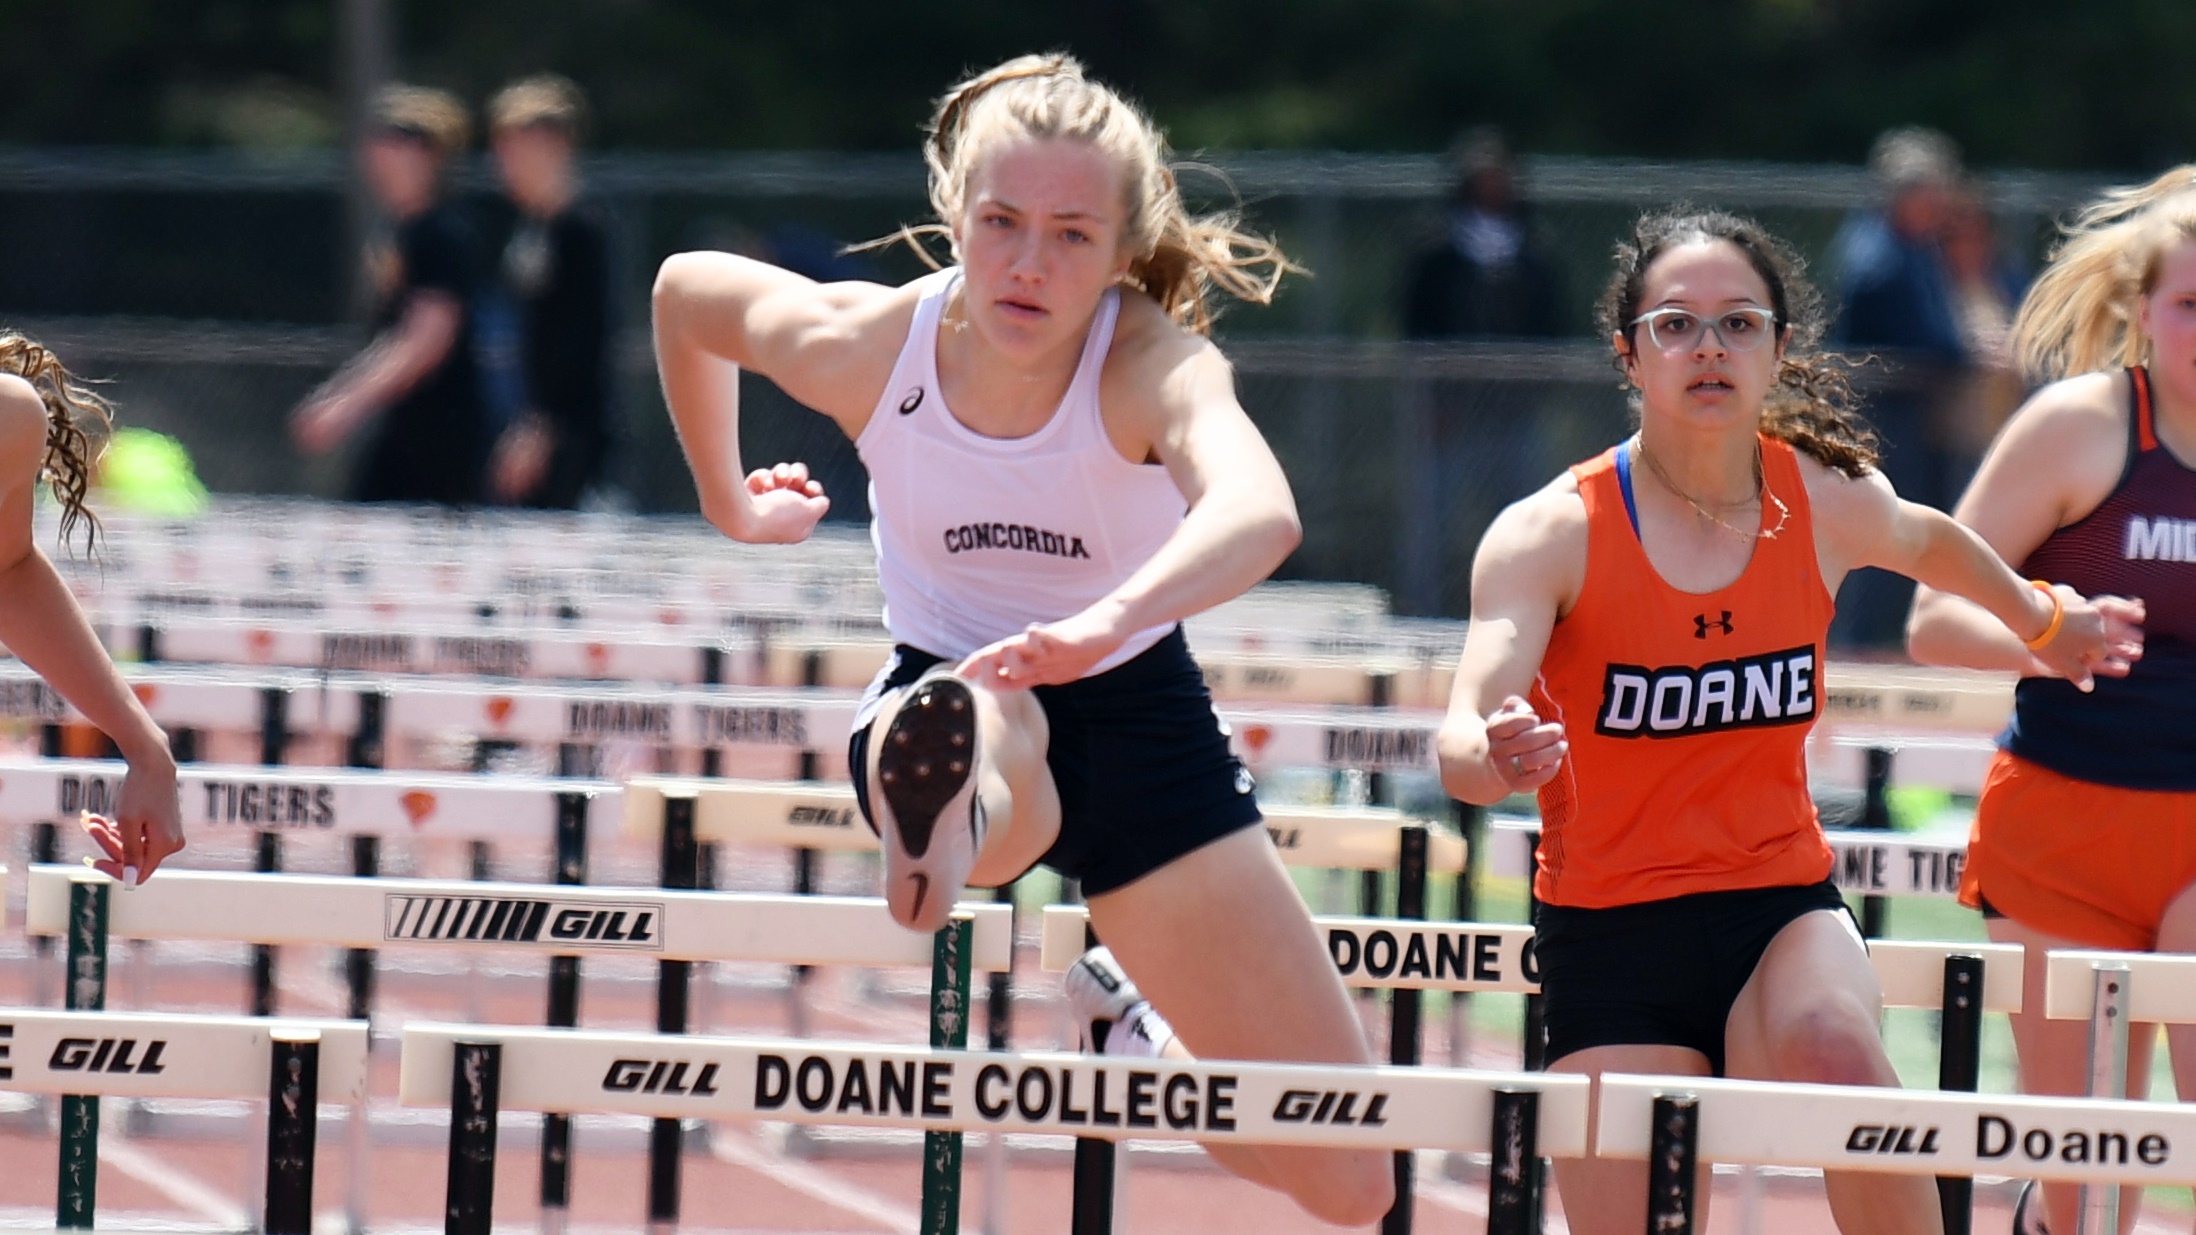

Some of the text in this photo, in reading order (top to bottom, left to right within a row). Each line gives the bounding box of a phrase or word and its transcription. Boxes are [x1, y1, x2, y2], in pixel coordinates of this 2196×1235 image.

[944, 522, 1091, 560] CONCORDIA
[1604, 655, 1813, 731] DOANE
[203, 781, 336, 828] TIGERS
[1908, 850, 1968, 893] TIG
[551, 909, 653, 941] GILL
[1329, 929, 1502, 982] DOANE
[48, 1038, 167, 1074] GILL
[602, 1054, 1391, 1131] GILL DOANE COLLEGE GILL
[1846, 1113, 2171, 1165] GILL Doane
